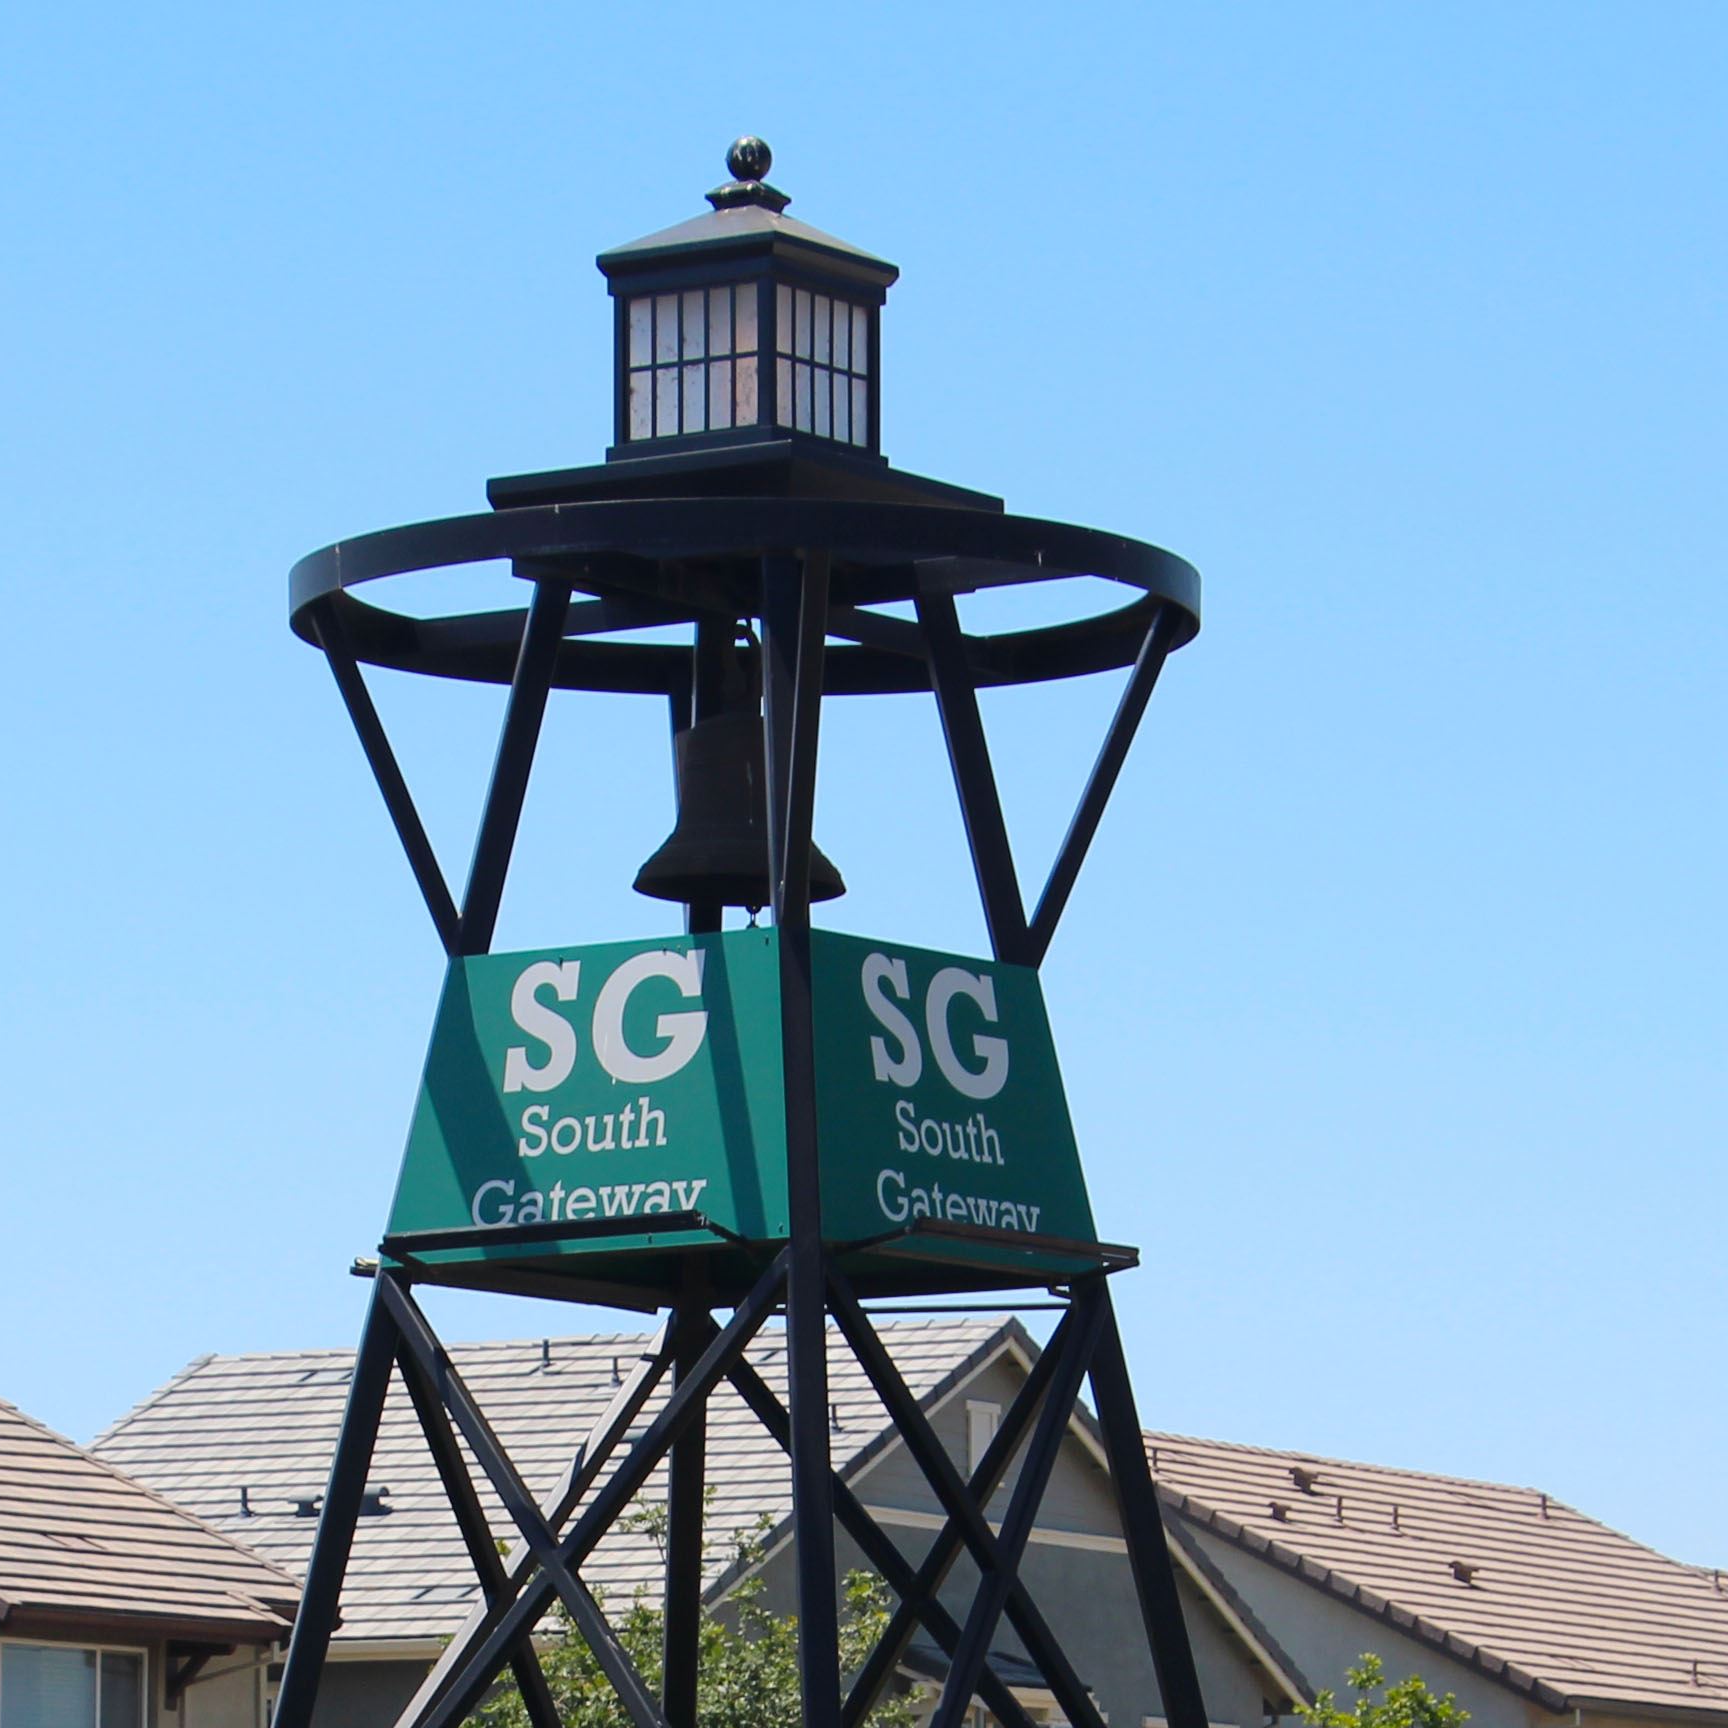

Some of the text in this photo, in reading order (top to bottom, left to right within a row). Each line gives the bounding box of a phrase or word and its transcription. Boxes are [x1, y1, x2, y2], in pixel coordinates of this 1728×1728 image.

[503, 948, 709, 1093] SG
[861, 952, 1010, 1100] SG
[518, 1096, 668, 1158] South
[895, 1099, 1005, 1166] South
